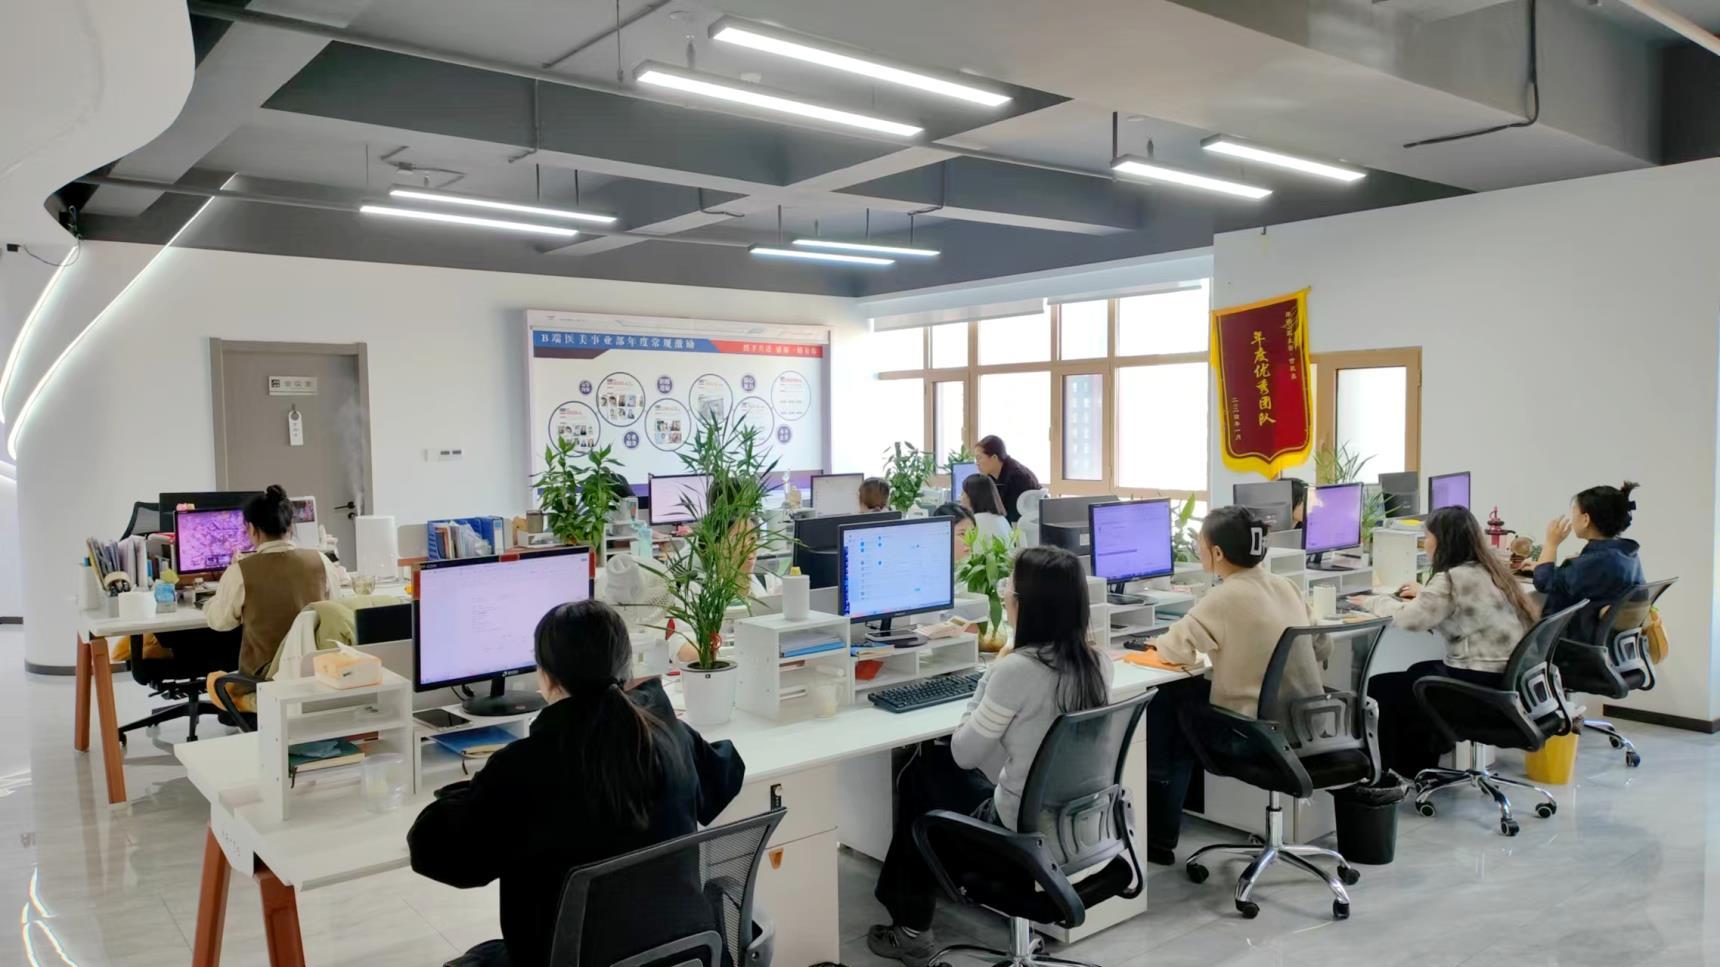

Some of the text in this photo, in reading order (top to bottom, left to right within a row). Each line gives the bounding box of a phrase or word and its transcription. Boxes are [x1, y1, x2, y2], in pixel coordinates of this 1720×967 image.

[1250, 330, 1277, 427] 年度优秀团队
